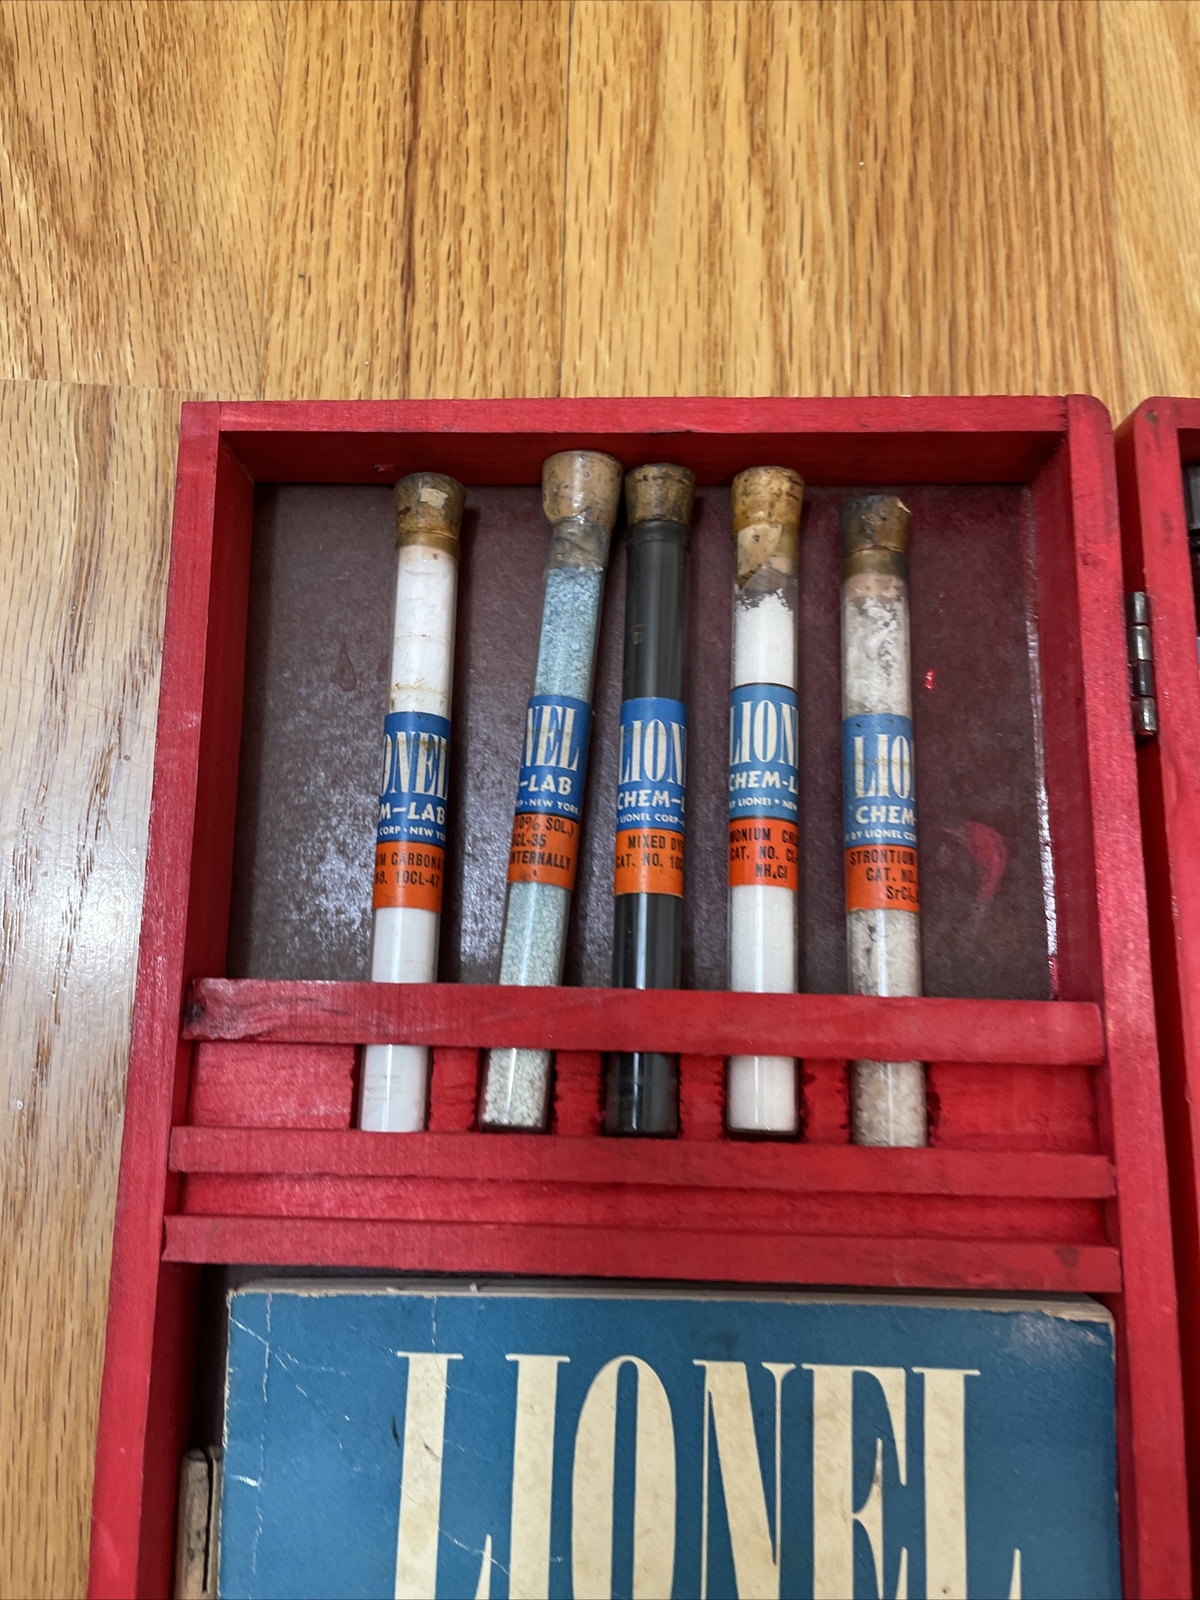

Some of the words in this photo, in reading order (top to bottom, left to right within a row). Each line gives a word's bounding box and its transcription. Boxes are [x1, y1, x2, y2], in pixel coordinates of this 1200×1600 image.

[529, 798, 554, 808] NEW
[738, 797, 772, 807] LIONEL
[409, 826, 434, 837] NEW
[865, 829, 903, 839] LIONEL
[628, 835, 666, 849] MIXED
[759, 846, 779, 860] NO.
[643, 853, 664, 868] NO.
[866, 867, 896, 882] CAT.
[393, 1351, 1022, 1600] LIONEL
